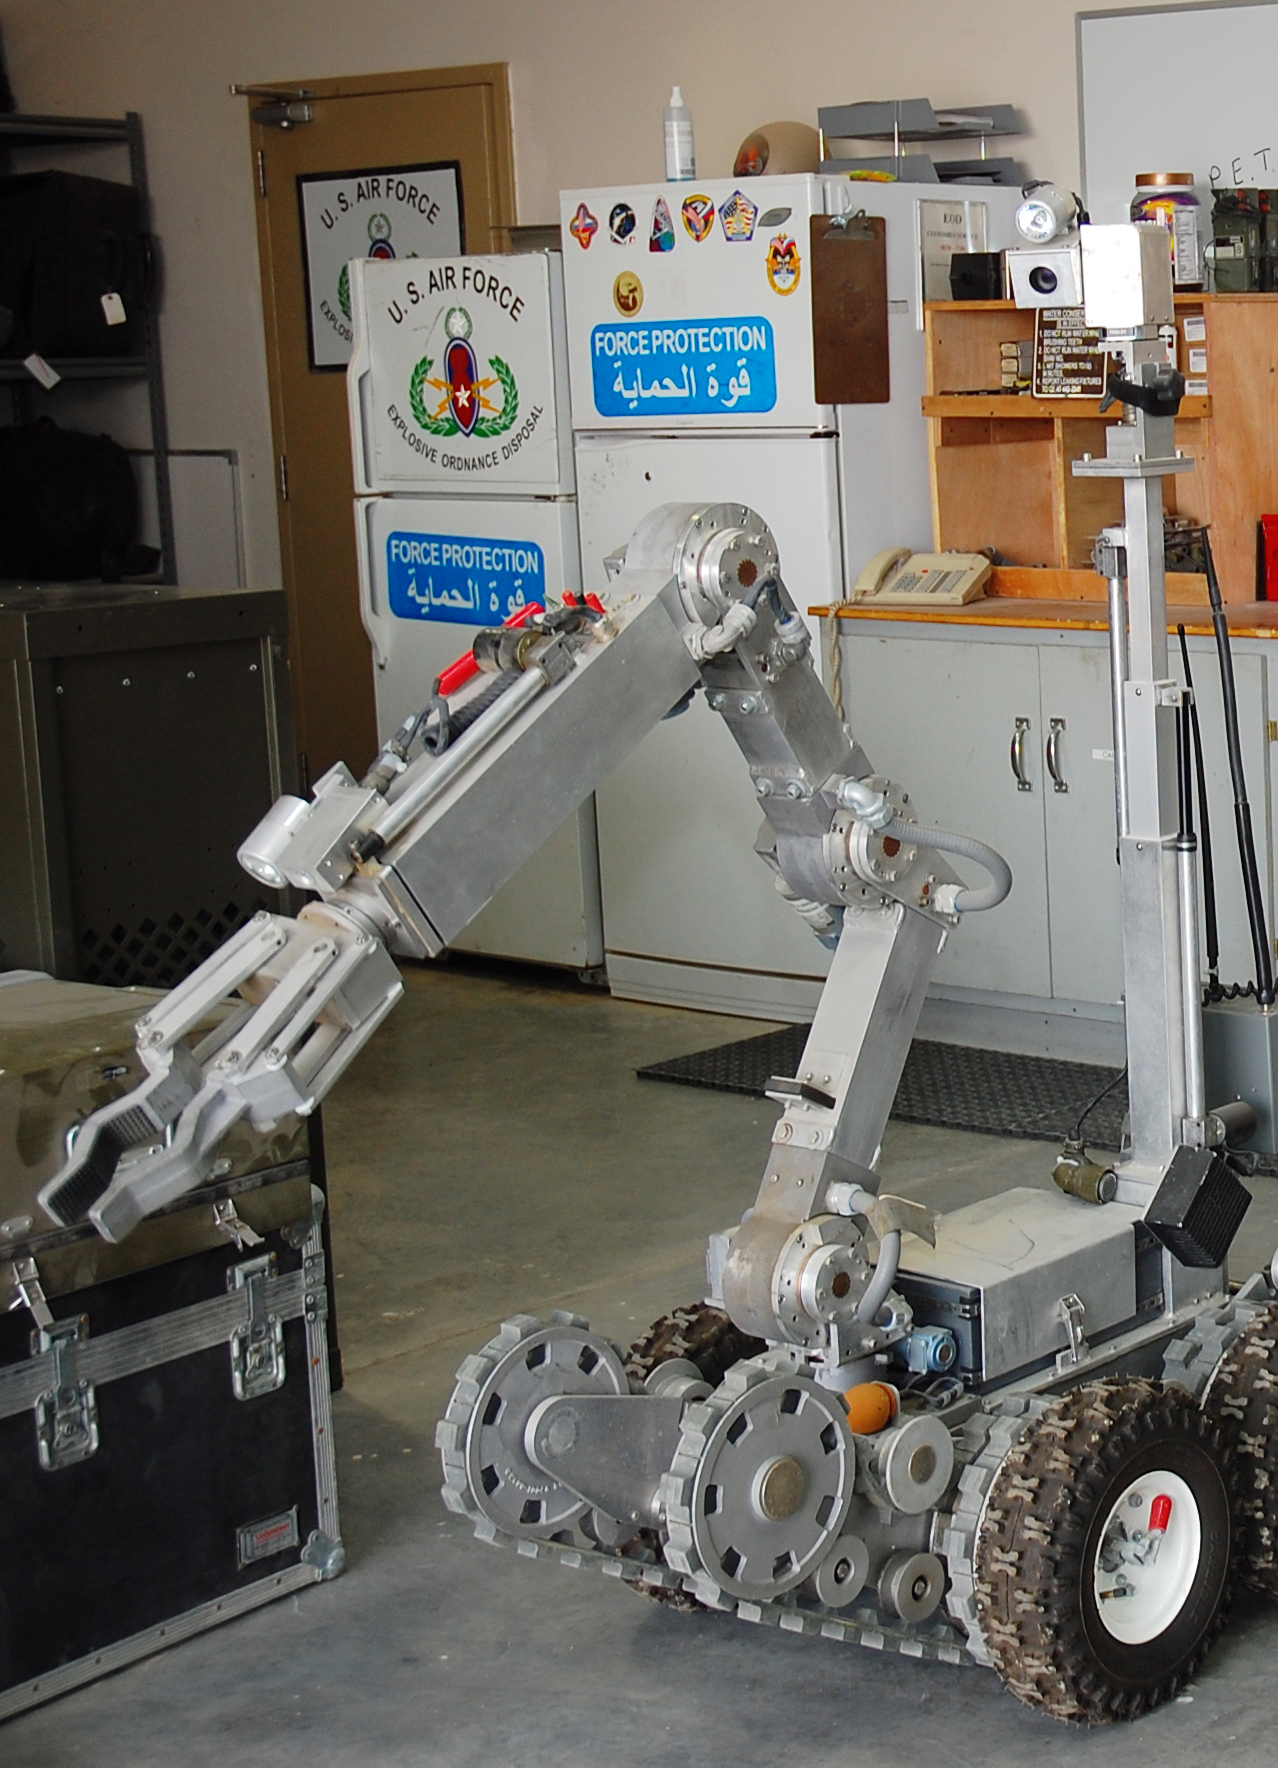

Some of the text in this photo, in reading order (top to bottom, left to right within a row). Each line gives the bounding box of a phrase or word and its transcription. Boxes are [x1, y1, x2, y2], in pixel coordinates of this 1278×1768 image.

[356, 178, 382, 203] AIR
[386, 178, 441, 225] FORCE
[428, 266, 458, 295] AIR
[462, 267, 525, 322] FORCE
[319, 300, 353, 344] EXPLOSI
[594, 325, 766, 357] FORCE PROTECTION
[613, 357, 751, 410] قوة الحماية
[387, 403, 544, 472] EXPLOSIVE ORDNANCE DISPOSAL
[390, 539, 539, 574] FORCE PROTECTION
[407, 568, 481, 614] الحماية
